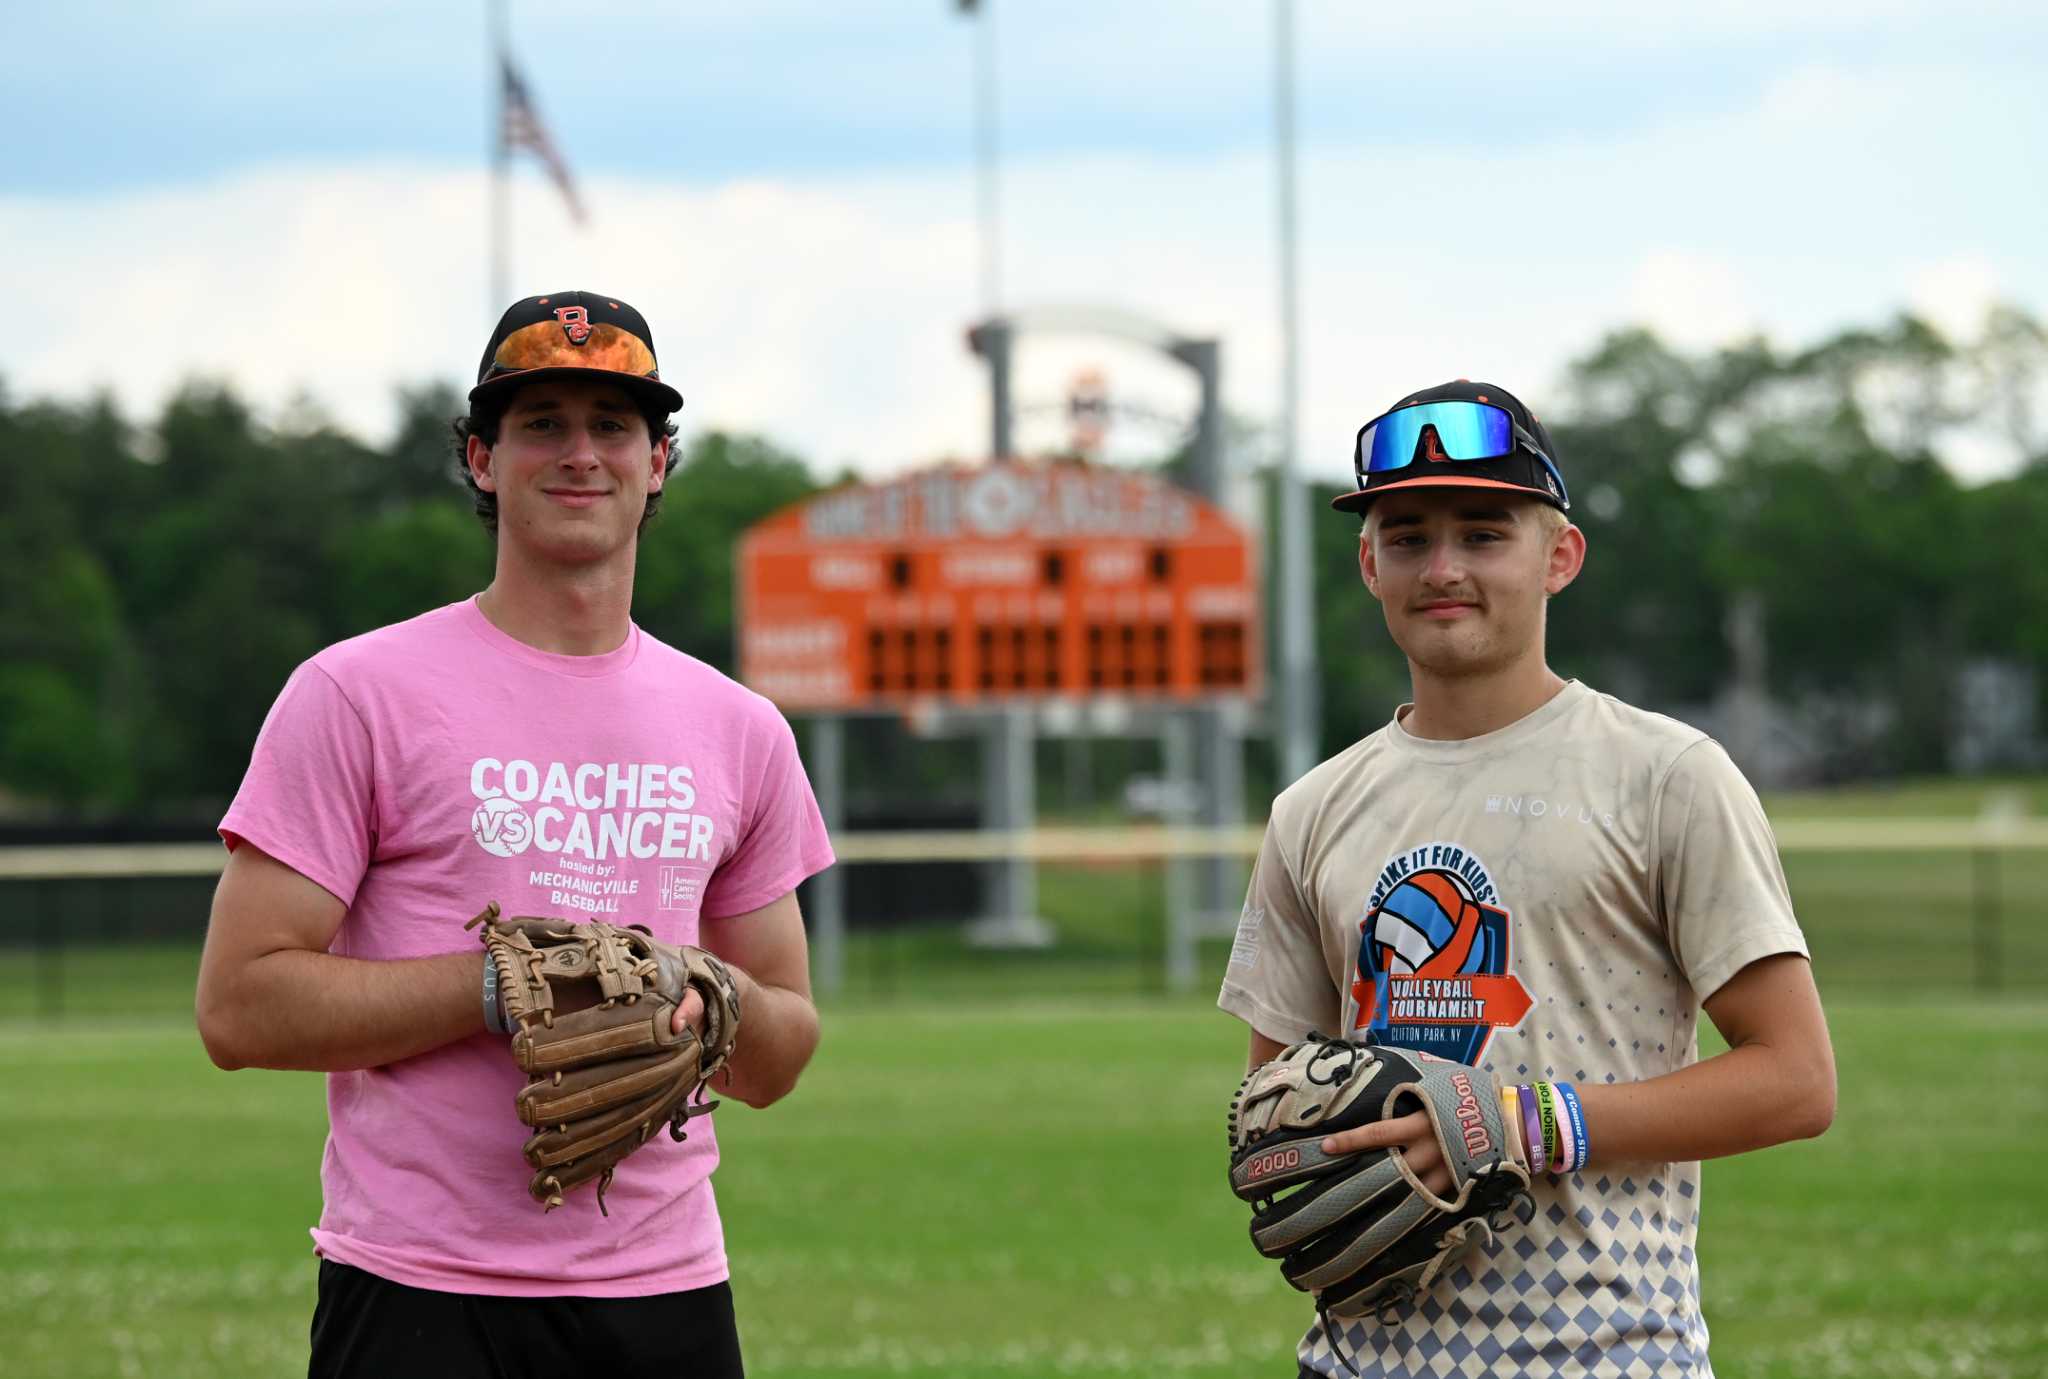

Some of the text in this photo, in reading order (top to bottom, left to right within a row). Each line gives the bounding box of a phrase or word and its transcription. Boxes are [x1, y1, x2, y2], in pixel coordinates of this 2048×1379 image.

[470, 757, 697, 810] COACHES
[1505, 796, 1614, 831] NOVUS
[476, 806, 715, 861] VS CANCER
[559, 857, 616, 876] hosted by:
[1412, 847, 1428, 869] IT
[1432, 845, 1464, 870] FOR
[529, 871, 640, 897] MECHANICVILLE
[551, 890, 620, 913] BASEBALL
[1390, 979, 1473, 998] VOLLEYBALL
[1391, 999, 1486, 1019] TOURNAMENT
[1391, 1026, 1420, 1042] CLIFTON
[1451, 1028, 1462, 1042] NY
[1450, 1070, 1491, 1159] Wilson
[1543, 1107, 1553, 1154] MISSION
[1247, 1148, 1300, 1178] A2000
[1532, 1145, 1541, 1159] BE
